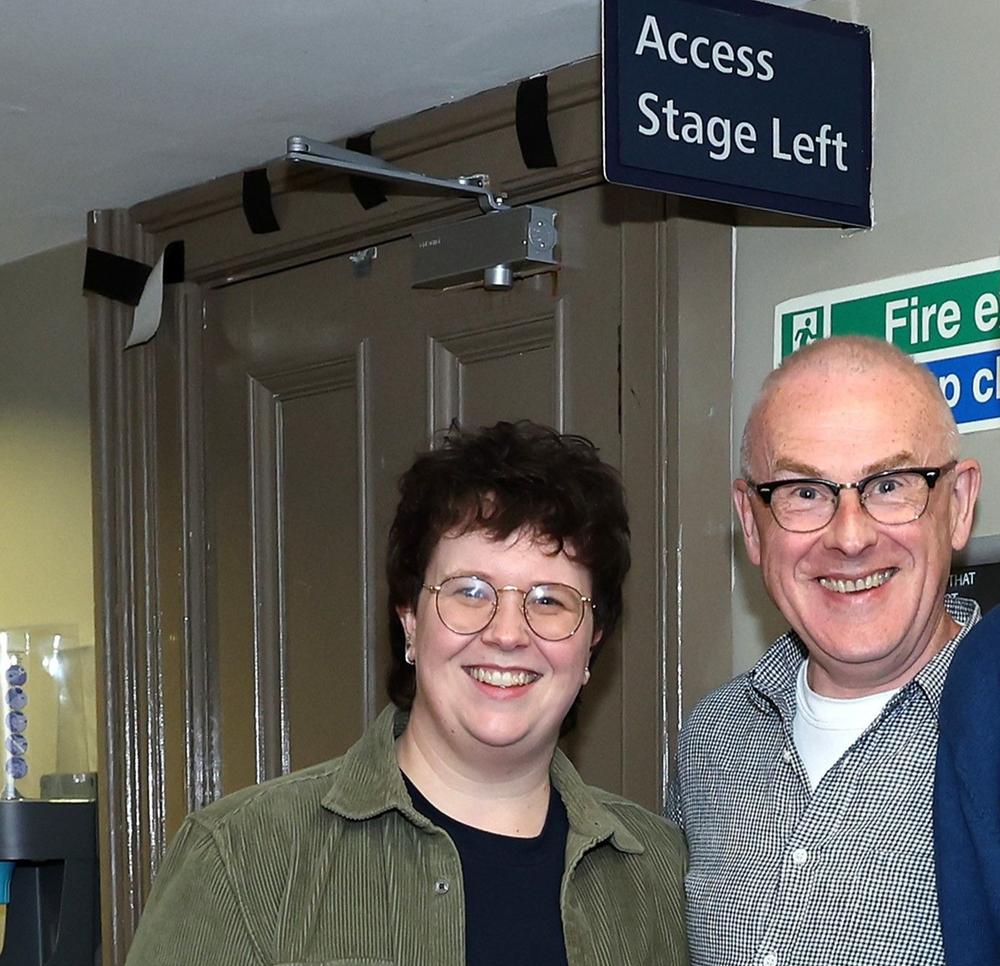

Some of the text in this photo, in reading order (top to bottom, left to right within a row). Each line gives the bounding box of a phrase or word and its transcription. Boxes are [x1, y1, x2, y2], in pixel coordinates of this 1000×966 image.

[635, 14, 774, 81] Access
[637, 92, 848, 171] Stage Left
[885, 296, 961, 345] Fire
[949, 571, 976, 588] THAT
